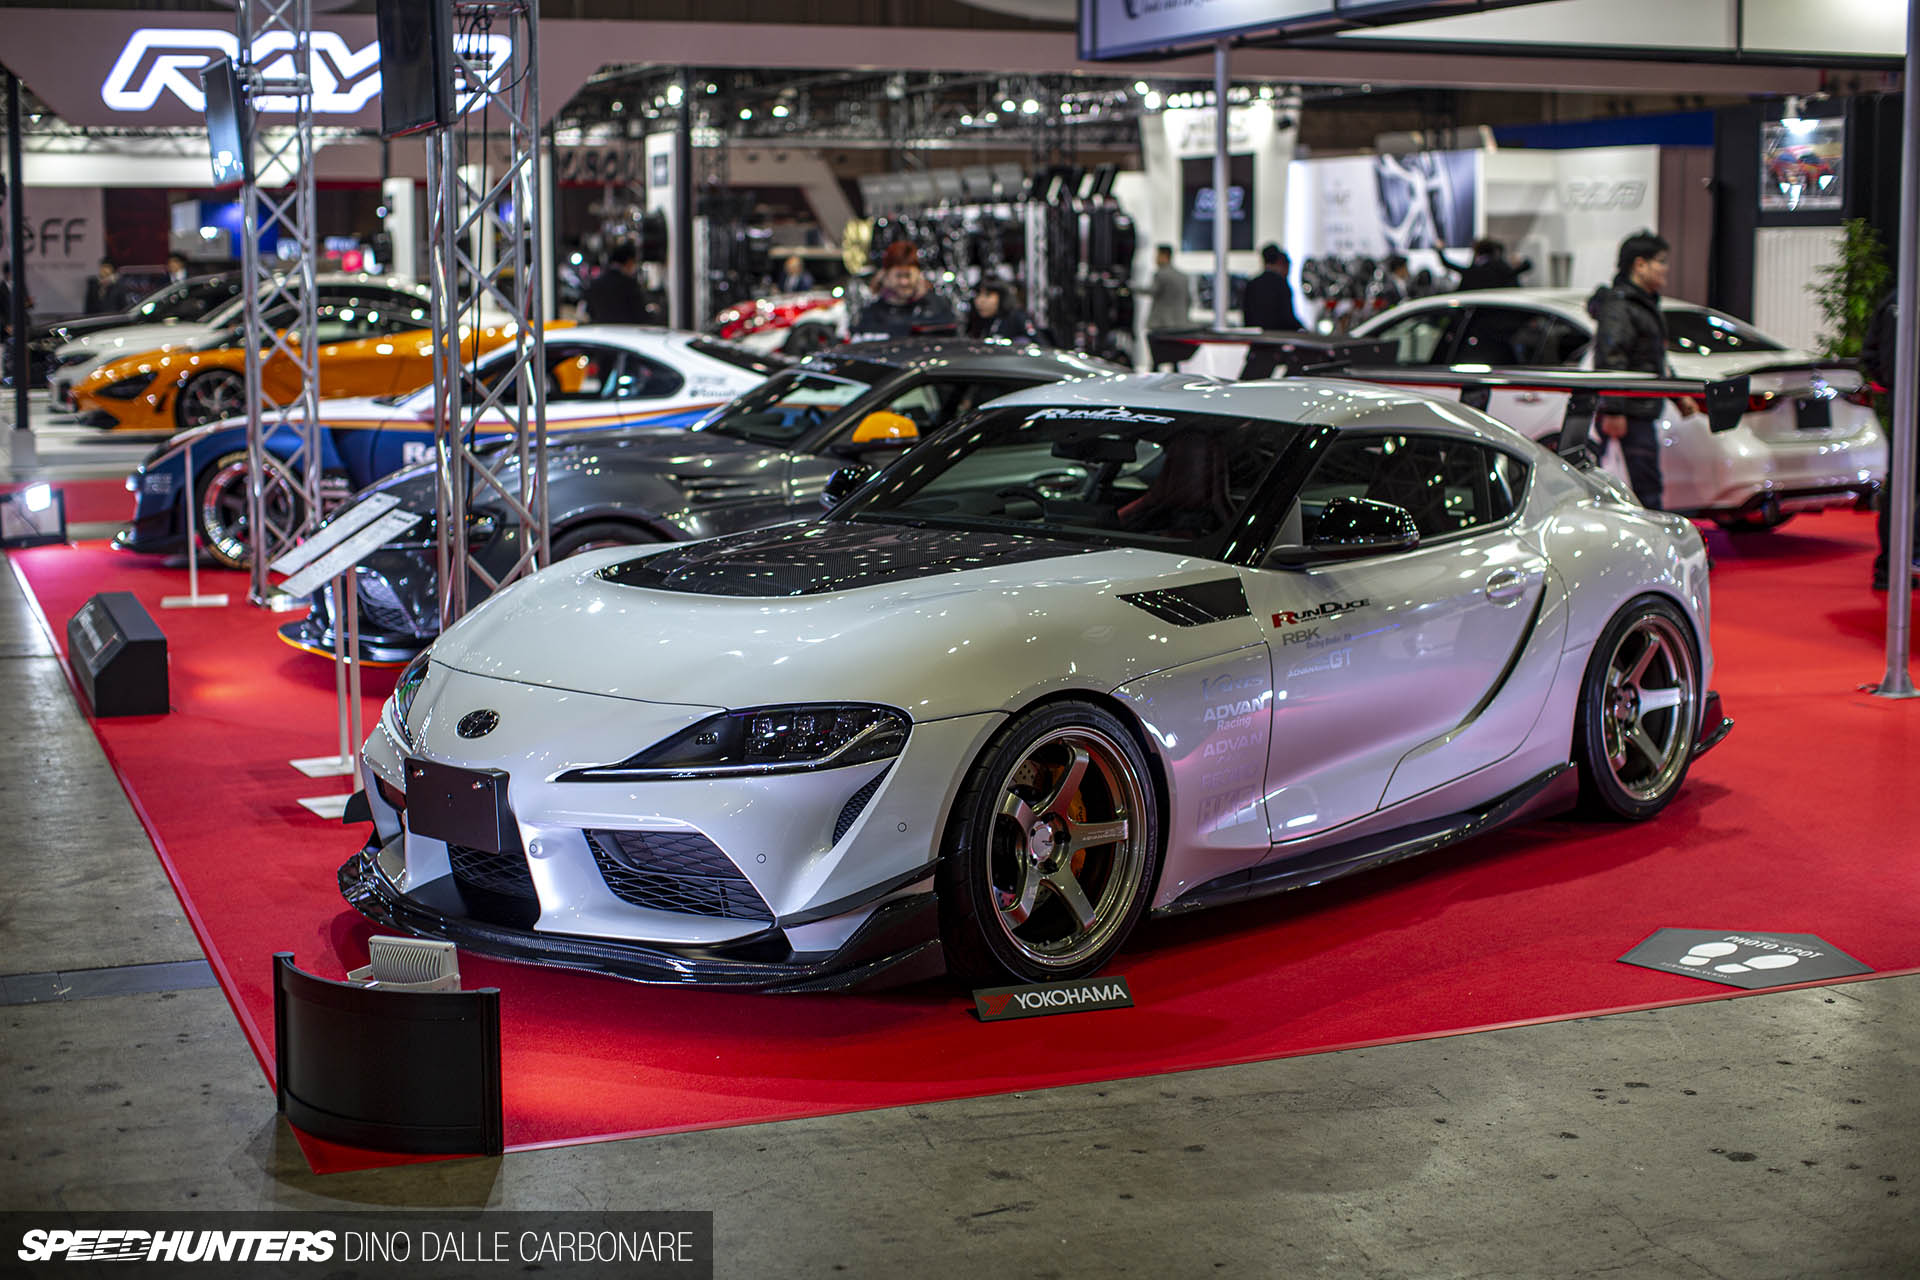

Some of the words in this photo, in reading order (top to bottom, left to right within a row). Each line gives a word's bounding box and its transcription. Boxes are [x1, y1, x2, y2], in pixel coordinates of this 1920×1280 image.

[1282, 626, 1321, 647] RBK
[1203, 696, 1265, 722] ADVAN
[1216, 715, 1252, 731] Racing
[1203, 731, 1263, 758] ADVAN
[1723, 935, 1779, 951] PHOTO
[1778, 946, 1825, 960] SPOT
[1013, 984, 1128, 1010] YOKOHAMA
